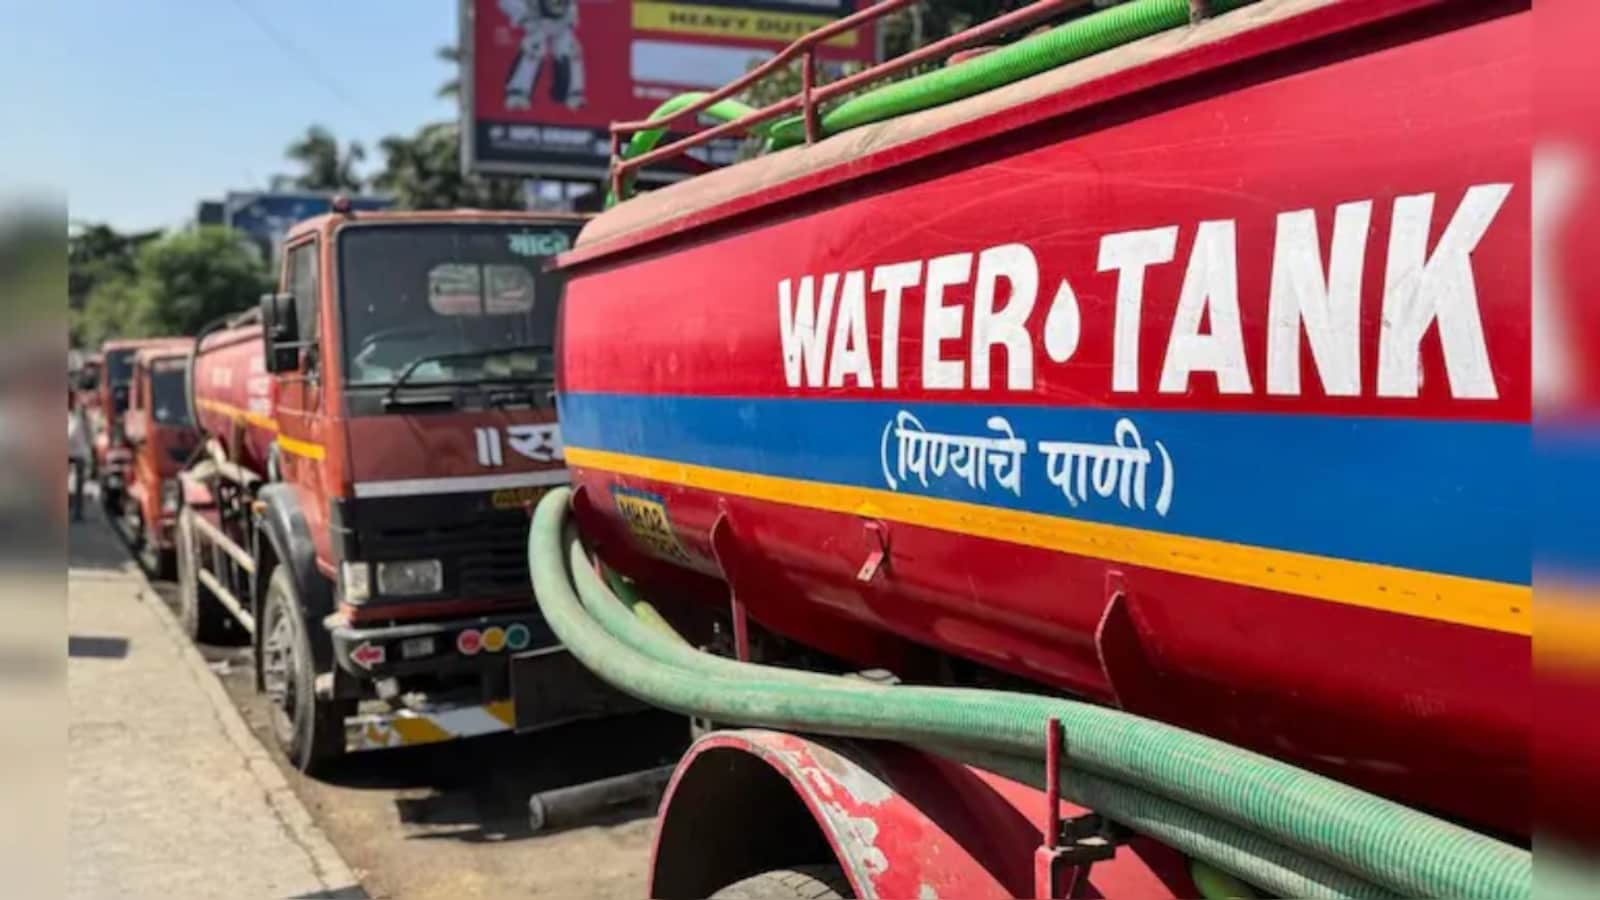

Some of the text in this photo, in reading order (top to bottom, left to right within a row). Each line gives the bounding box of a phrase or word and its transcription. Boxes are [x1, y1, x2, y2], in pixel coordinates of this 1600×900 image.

[777, 183, 1514, 400] WATER TANK
[880, 409, 1174, 517] (पिण्याचे पाणी)
